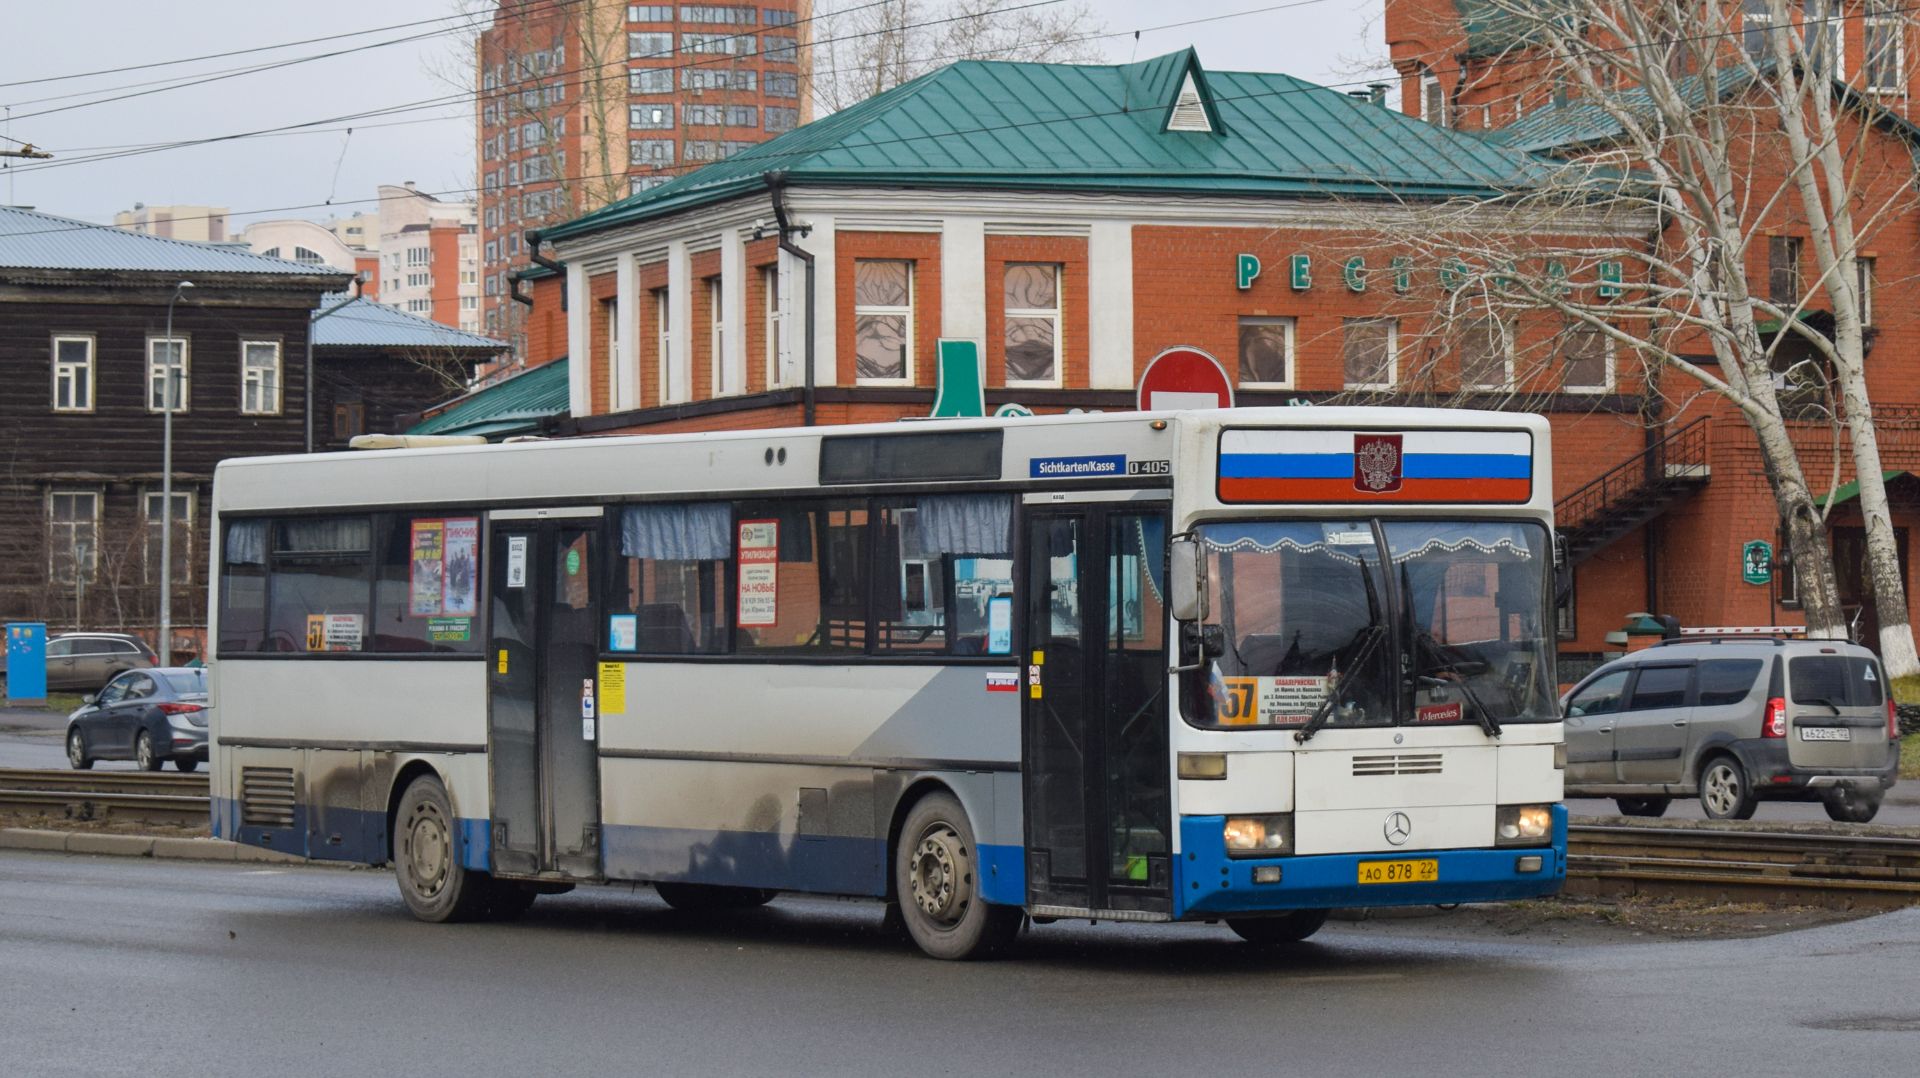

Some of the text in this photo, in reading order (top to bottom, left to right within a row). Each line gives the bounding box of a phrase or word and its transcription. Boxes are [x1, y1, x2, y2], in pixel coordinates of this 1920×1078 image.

[1235, 253, 1623, 298] РЕСТОРАН
[1039, 461, 1116, 474] Sichtkarten/Kasse
[1142, 461, 1169, 474] 405
[741, 582, 775, 593] НА НОВЫЕ
[309, 620, 323, 649] 57
[1221, 683, 1255, 718] 57
[1422, 709, 1458, 721] Mercedes
[1365, 862, 1434, 880] АО 878 22
